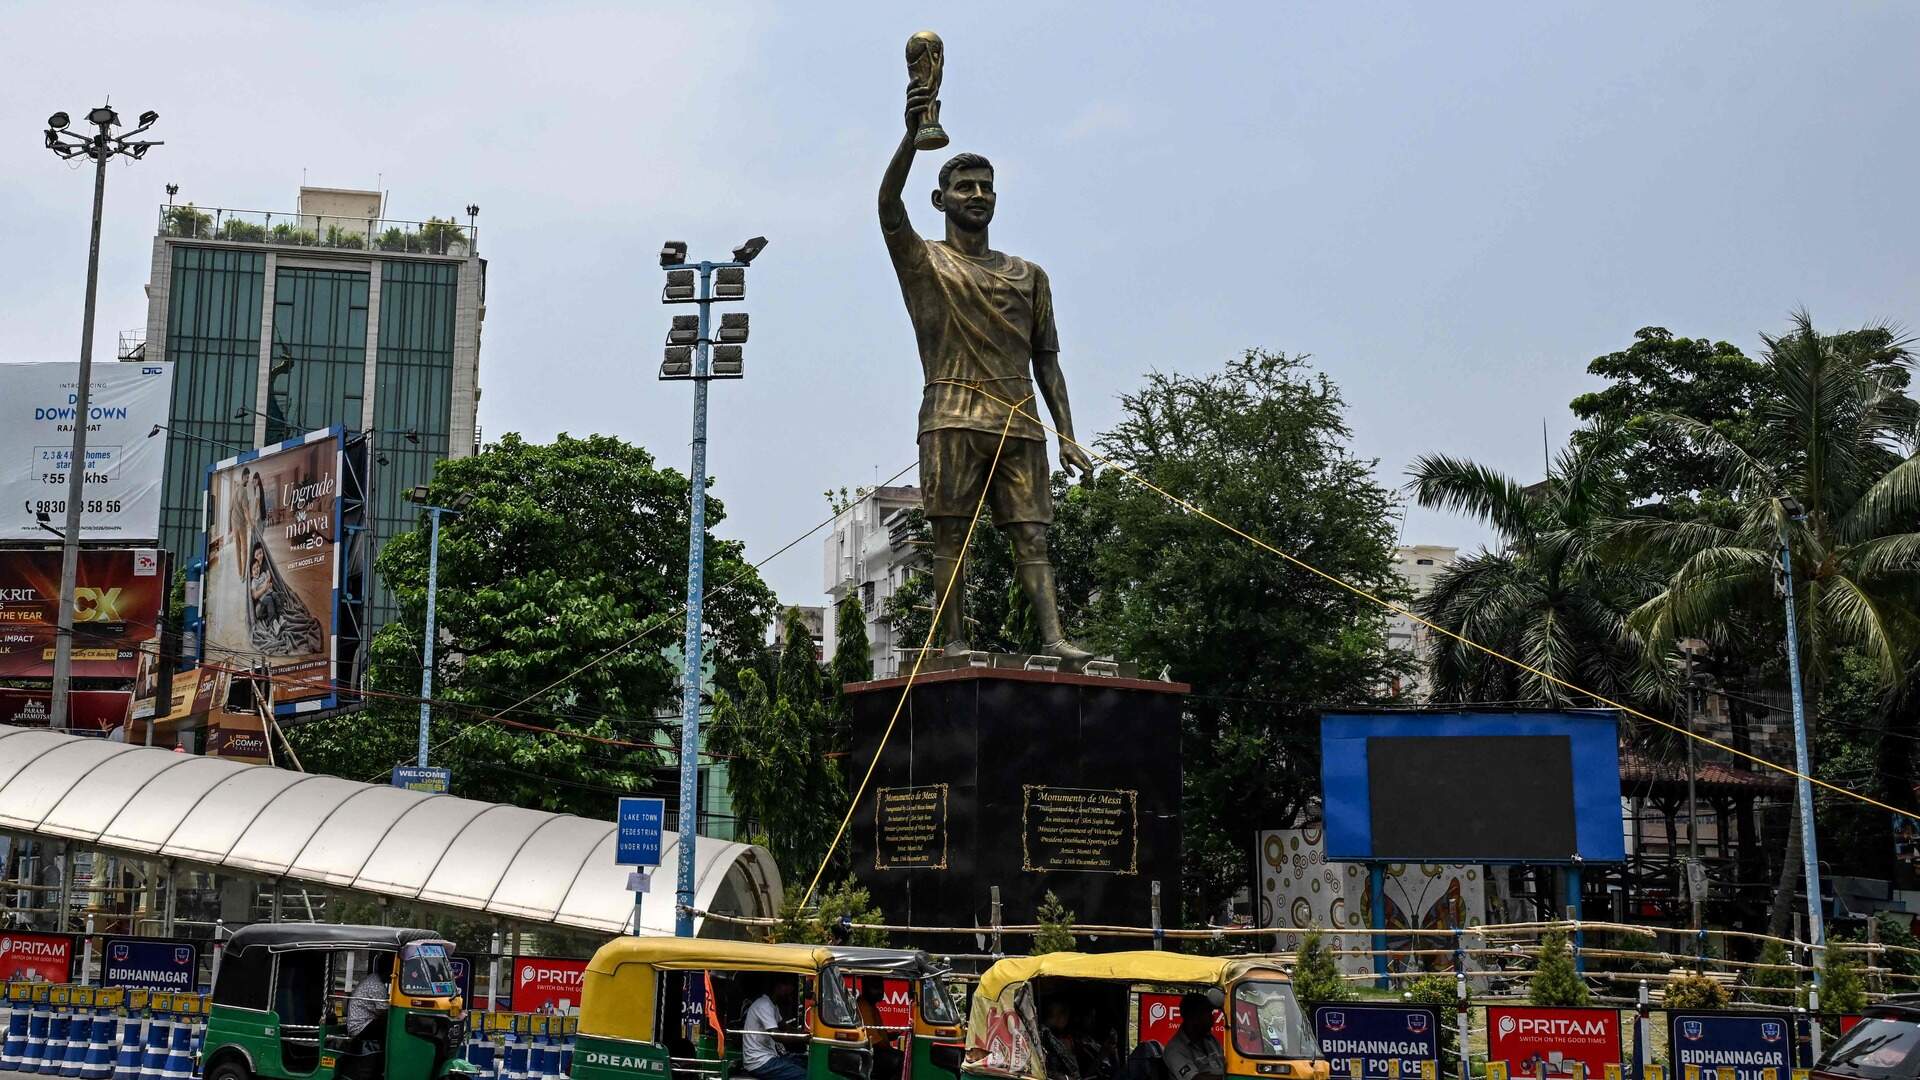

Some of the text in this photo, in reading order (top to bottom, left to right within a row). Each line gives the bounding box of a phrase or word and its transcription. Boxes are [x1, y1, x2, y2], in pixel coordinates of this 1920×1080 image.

[35, 407, 127, 420] DOWNOWN
[56, 451, 63, 459] &
[63, 451, 68, 460] 4
[86, 450, 111, 460] homes
[283, 472, 334, 512] Upgrade
[88, 500, 102, 513] 58
[106, 500, 121, 513] 56
[285, 514, 329, 539] morva
[17, 611, 43, 620] YEAR
[4, 635, 35, 643] IMPACT
[235, 739, 263, 748] COMFY
[399, 770, 447, 779] WELCOME
[1037, 792, 1122, 805] Monumento de Messi
[623, 813, 658, 822] LAKE TOWN
[621, 828, 658, 837] PEDESTRIAN
[620, 842, 658, 851] UNDER PASS
[12, 940, 65, 957] PRITAM
[109, 968, 189, 983] BIDHANNAGAR
[537, 969, 584, 985] PRITA
[1518, 1018, 1606, 1036] PRITAM
[1519, 1035, 1543, 1043] SWITCH
[1322, 1039, 1429, 1055] BIDHANNAGAR
[586, 1053, 648, 1070] DREAM
[1680, 1049, 1783, 1065] BIDHANNAGAR
[1331, 1058, 1421, 1073] CIT POCE
